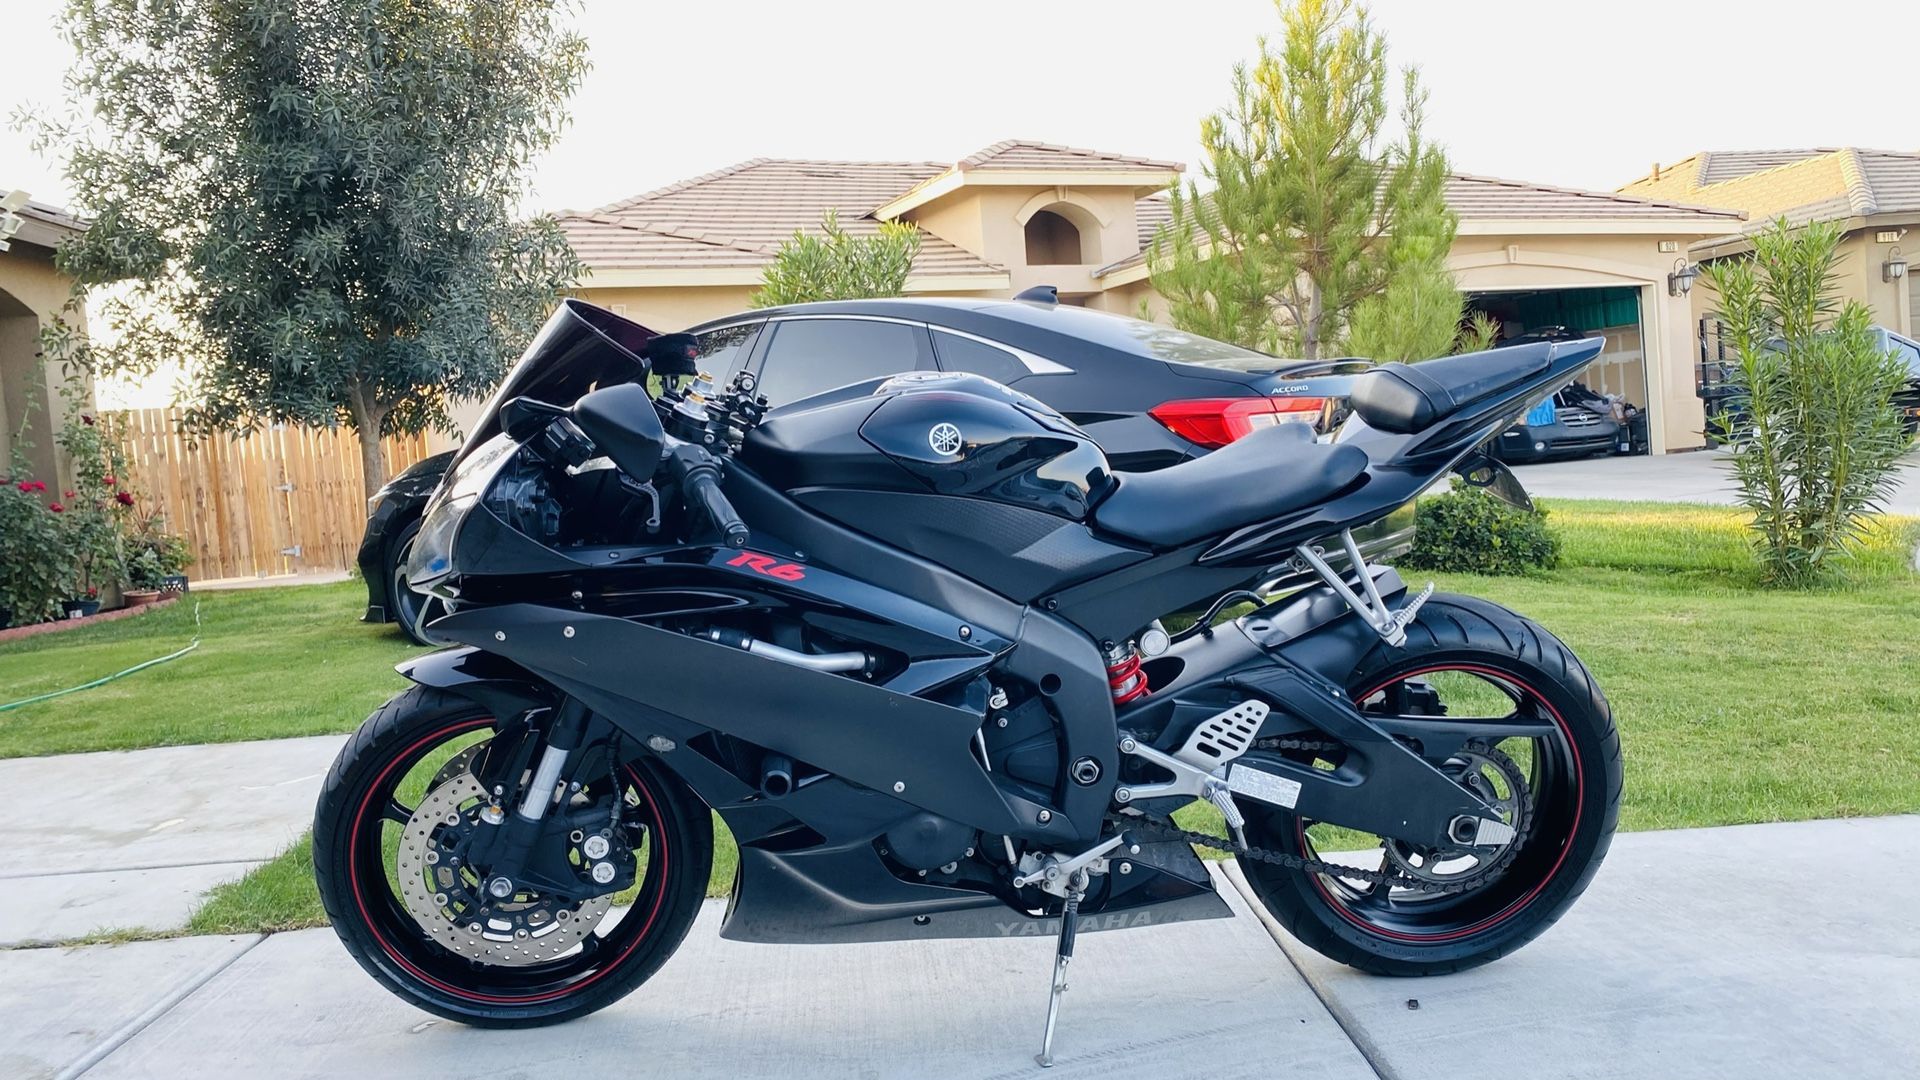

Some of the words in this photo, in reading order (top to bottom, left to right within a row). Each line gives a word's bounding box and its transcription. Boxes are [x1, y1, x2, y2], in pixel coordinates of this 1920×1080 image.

[1271, 384, 1309, 394] ACCORD
[725, 551, 806, 581] R6
[995, 910, 1151, 936] YAMAHA
